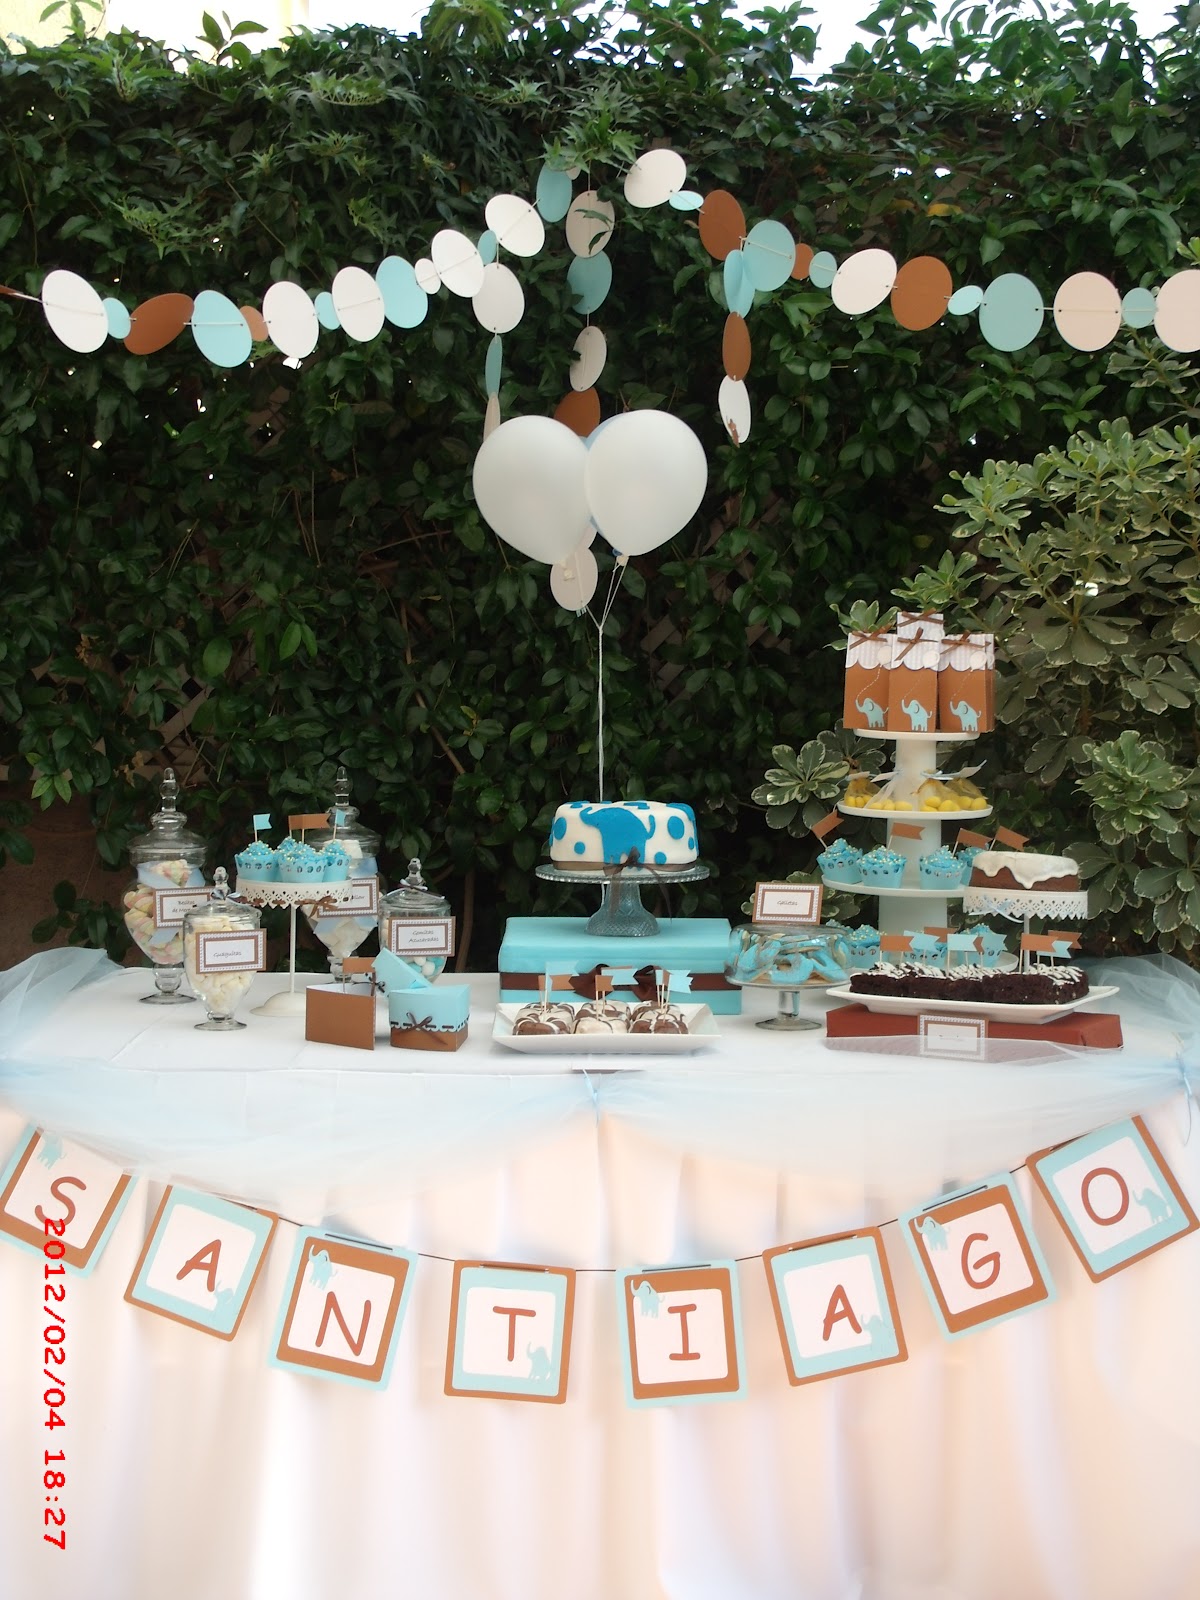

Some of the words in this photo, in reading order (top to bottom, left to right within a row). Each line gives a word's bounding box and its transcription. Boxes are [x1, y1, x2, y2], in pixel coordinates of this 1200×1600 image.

[35, 1176, 87, 1227] S
[176, 1239, 222, 1292] A
[312, 1291, 372, 1356] N
[493, 1305, 537, 1362] T
[667, 1303, 701, 1361] I
[822, 1284, 862, 1341] A
[960, 1232, 1001, 1290] G
[1080, 1167, 1129, 1226] O
